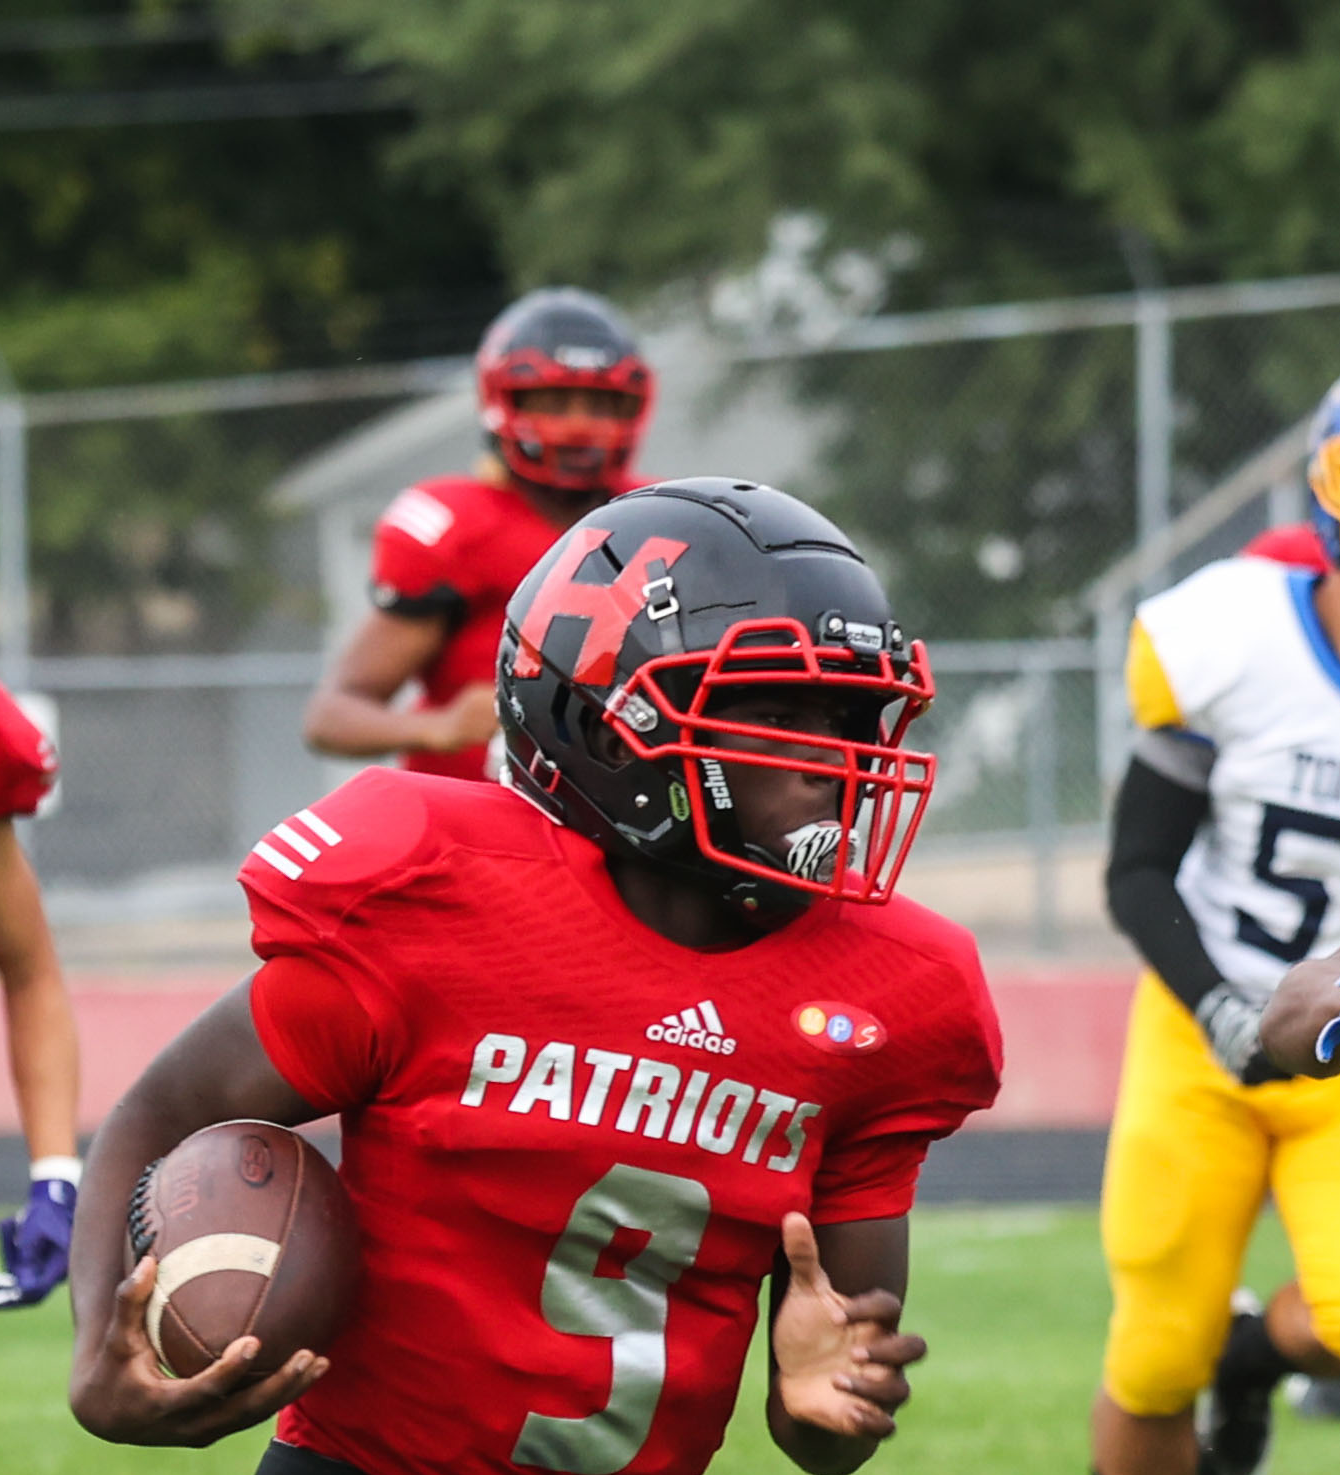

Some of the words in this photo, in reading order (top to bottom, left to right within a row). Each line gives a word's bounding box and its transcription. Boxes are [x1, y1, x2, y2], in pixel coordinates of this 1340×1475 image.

[700, 757, 734, 810] schut
[645, 1023, 737, 1056] adidas
[459, 1033, 823, 1174] PATRIOTS
